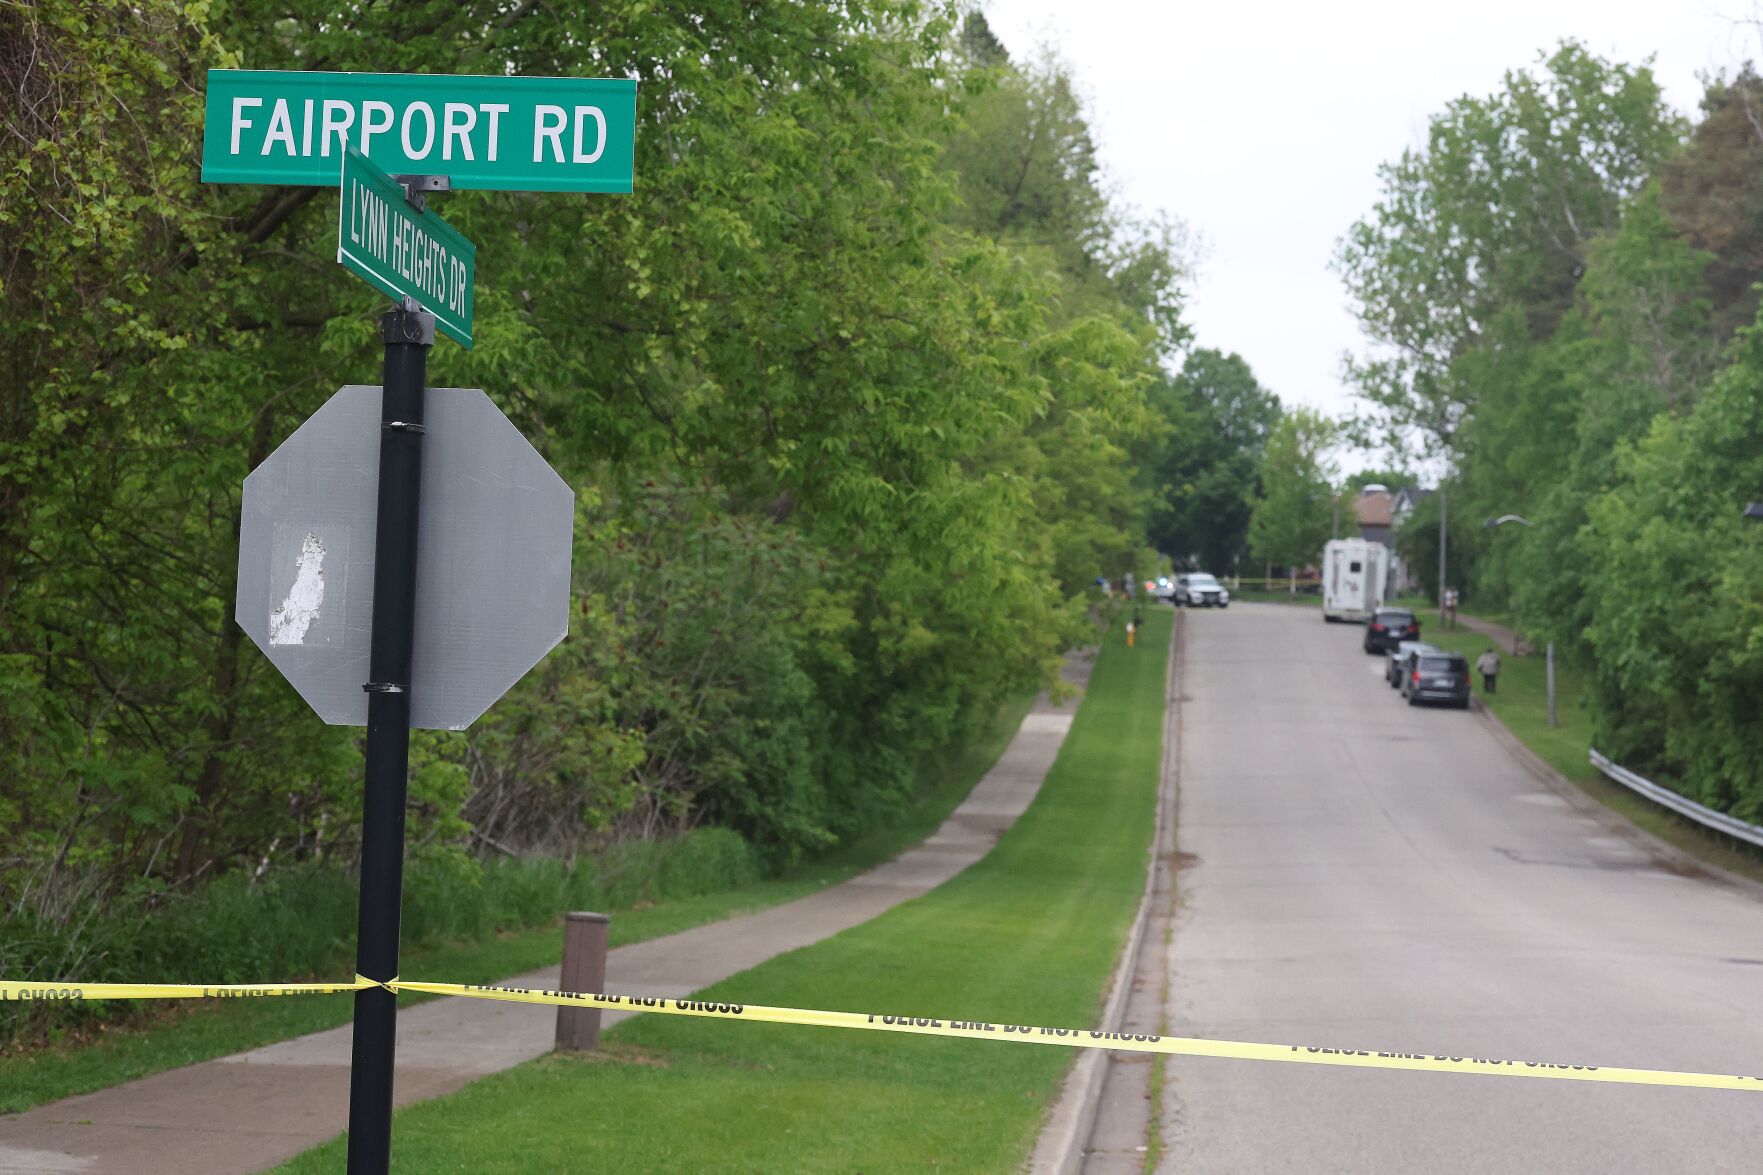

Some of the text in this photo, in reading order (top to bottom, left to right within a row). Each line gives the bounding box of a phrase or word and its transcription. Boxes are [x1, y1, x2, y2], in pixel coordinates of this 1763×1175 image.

[230, 97, 608, 164] FAIRPORT RD
[351, 177, 467, 319] LYNN HEIGHTS DR
